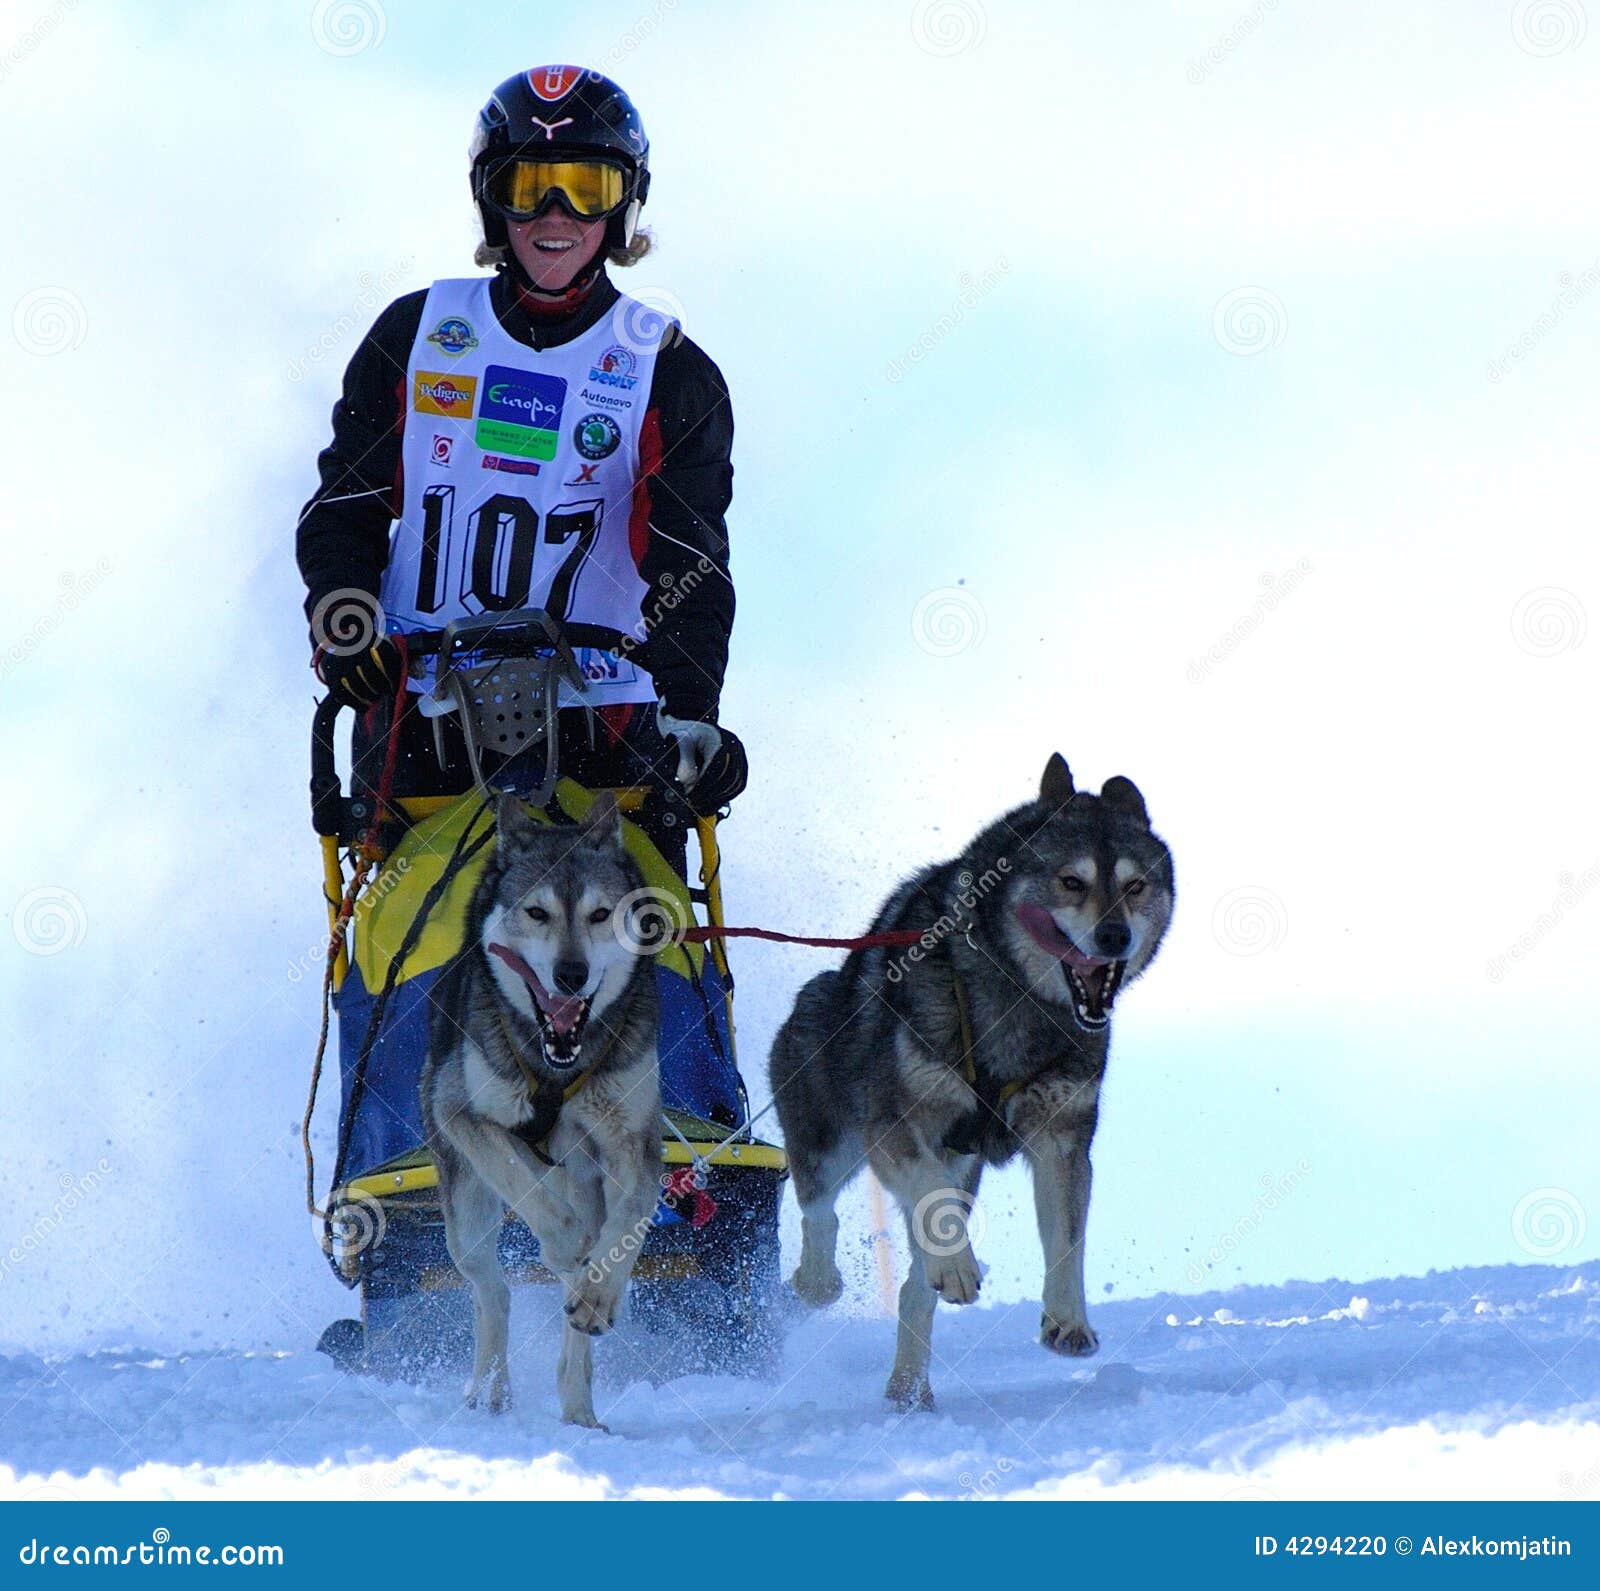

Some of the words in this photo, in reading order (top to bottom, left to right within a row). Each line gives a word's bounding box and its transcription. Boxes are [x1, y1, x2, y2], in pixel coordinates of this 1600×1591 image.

[419, 382, 470, 403] Pedigree
[488, 383, 557, 423] Europa
[580, 388, 632, 409] Autonovo
[415, 484, 605, 623] 107
